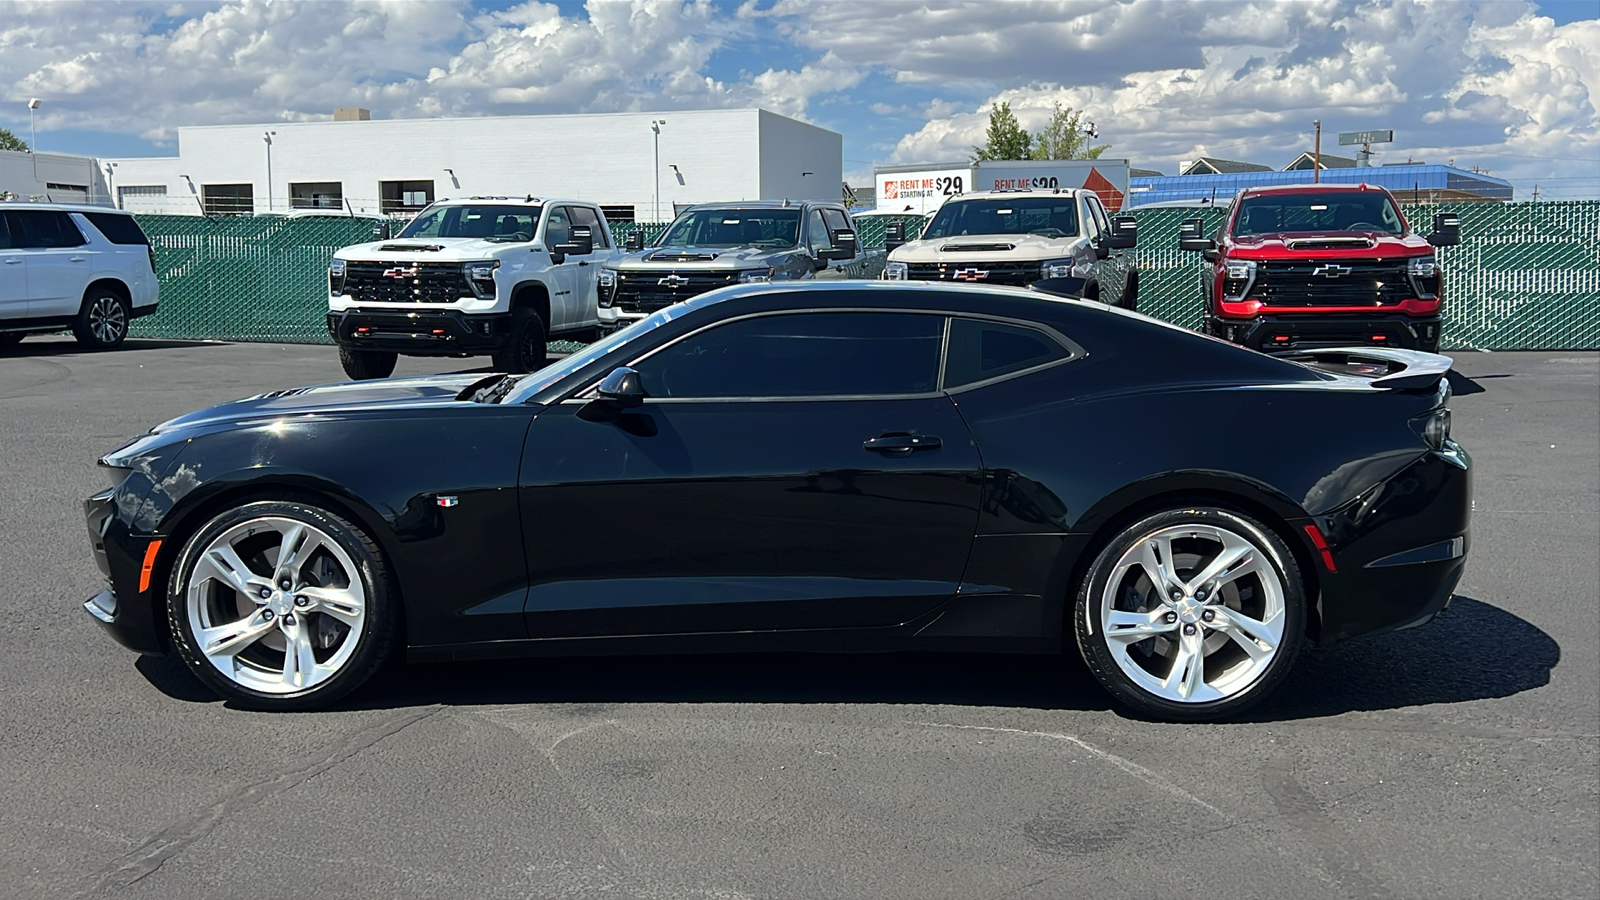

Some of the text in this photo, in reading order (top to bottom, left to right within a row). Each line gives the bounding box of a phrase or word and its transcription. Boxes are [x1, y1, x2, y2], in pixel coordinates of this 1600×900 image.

[900, 179, 934, 189] RENT ME
[936, 176, 963, 196] $29
[994, 179, 1015, 190] RENT
[900, 190, 925, 199] STARTING
[926, 190, 933, 198] AT
